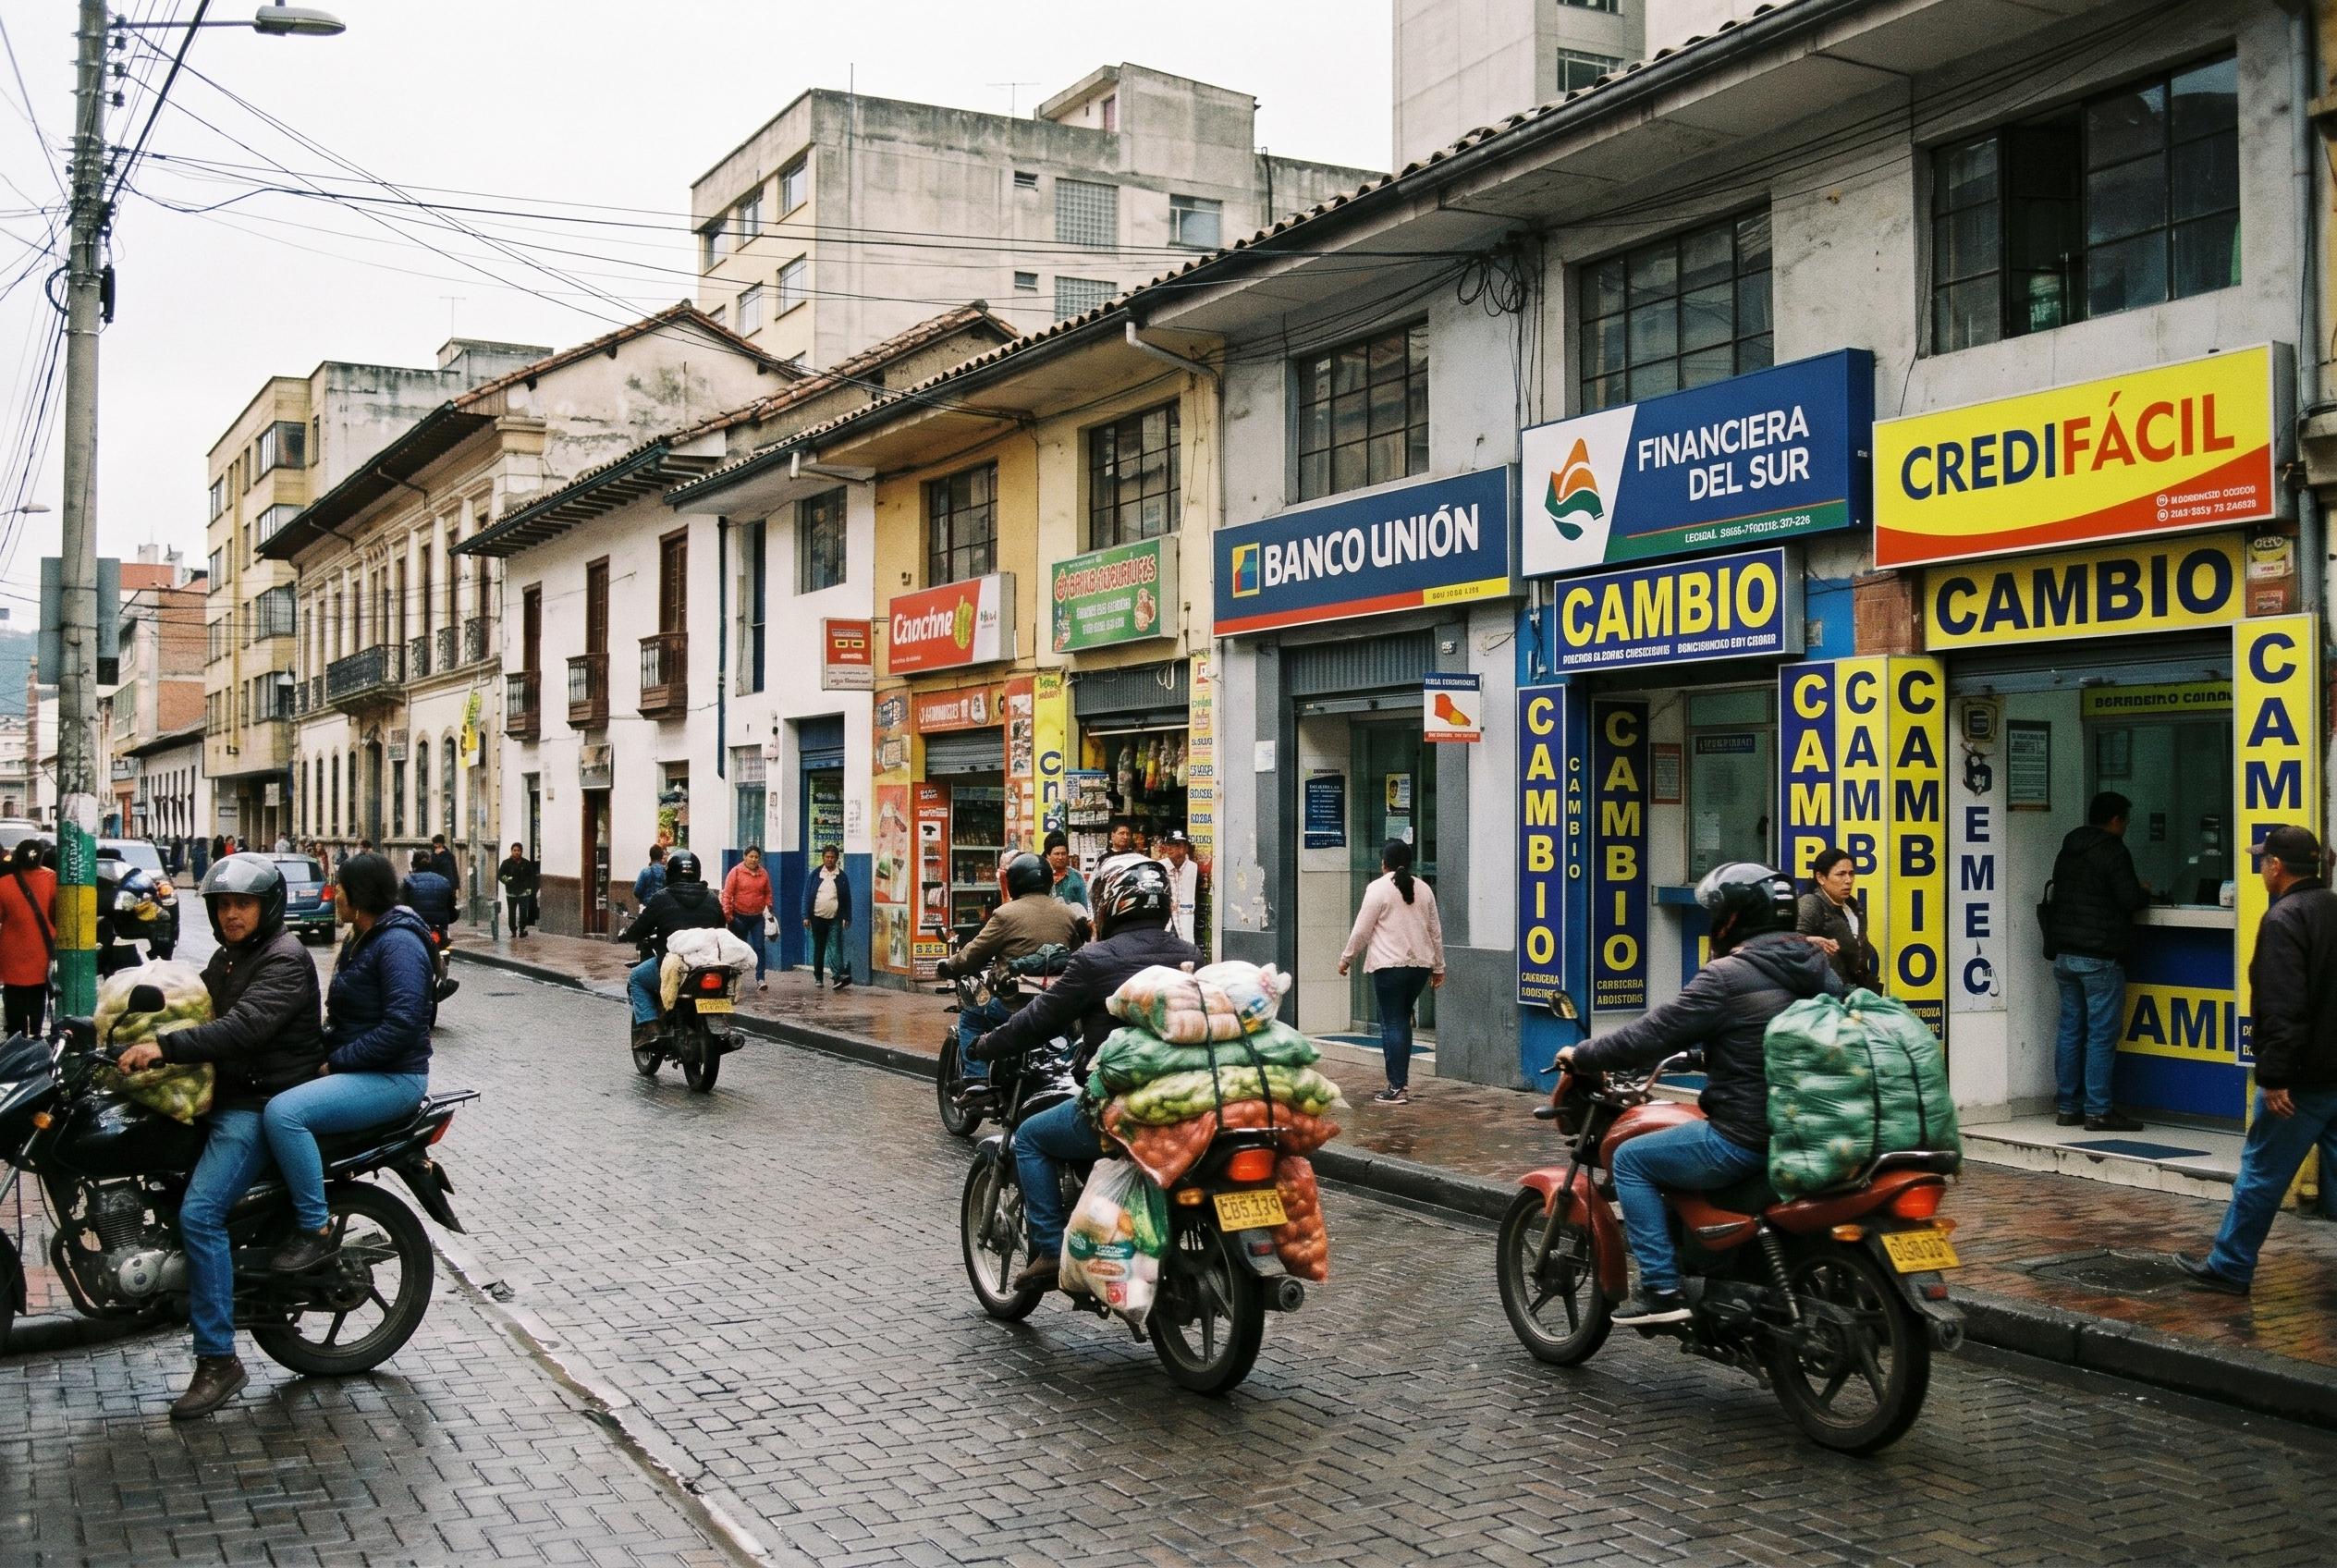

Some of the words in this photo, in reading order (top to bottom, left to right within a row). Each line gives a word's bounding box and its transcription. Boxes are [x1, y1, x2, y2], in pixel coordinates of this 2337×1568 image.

[1638, 405, 1809, 472] FINANCIERA
[1689, 463, 1743, 501] DEL
[1749, 447, 1810, 487] SUR
[1901, 390, 2235, 500] CREDIFÁCIL
[1265, 528, 1364, 587] BANCO
[1371, 503, 1478, 568] UNIÓN
[1936, 547, 2233, 636] CAMBIO
[1562, 562, 1777, 647] CAMBIO
[1790, 674, 1831, 879] CAMB
[2245, 632, 2302, 876] CAM
[1525, 697, 1558, 965] CAMBIO
[1568, 757, 1581, 879] CAMBIO
[1601, 710, 1641, 972] CAMBIO
[1895, 670, 1939, 987] CAMBIO
